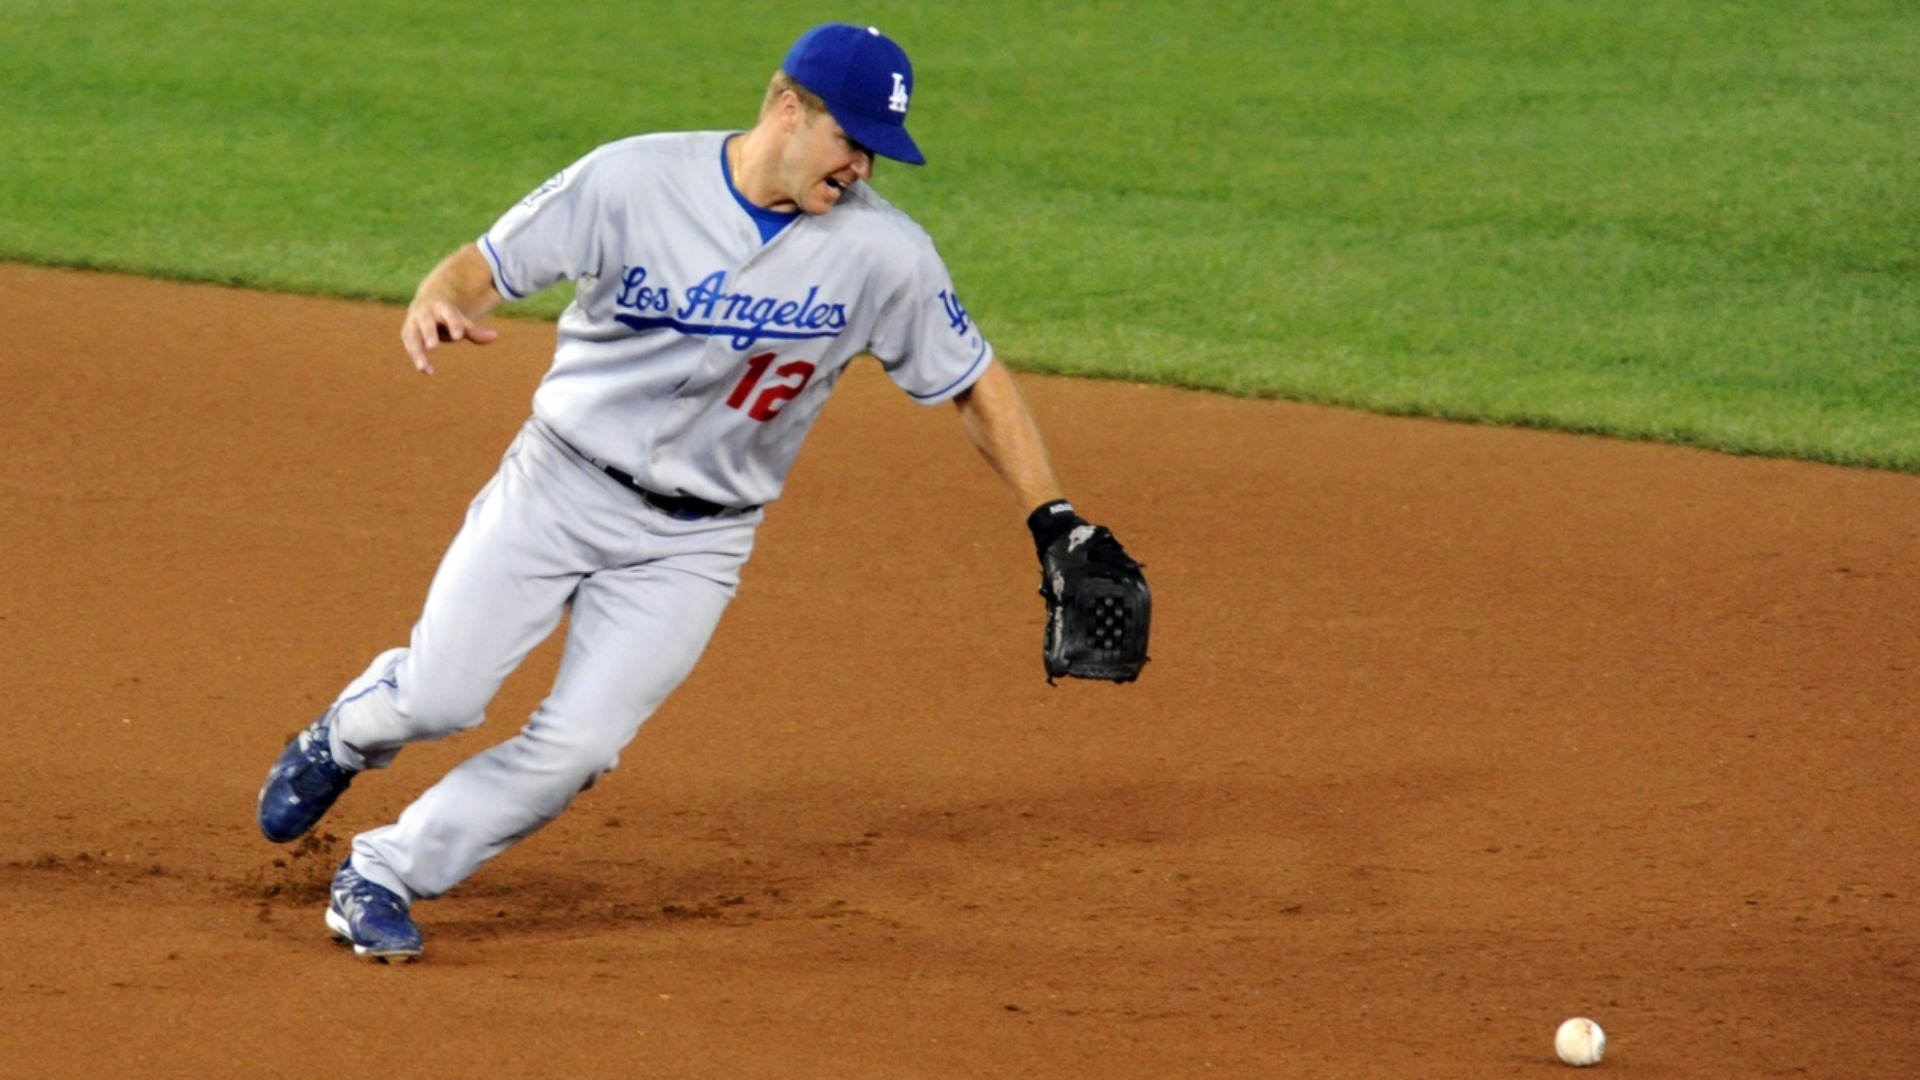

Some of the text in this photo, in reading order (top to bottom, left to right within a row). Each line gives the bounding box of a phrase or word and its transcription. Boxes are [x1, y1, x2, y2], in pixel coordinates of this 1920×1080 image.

[888, 72, 908, 113] LA
[616, 266, 846, 351] Los Angeles
[726, 352, 816, 422] 12
